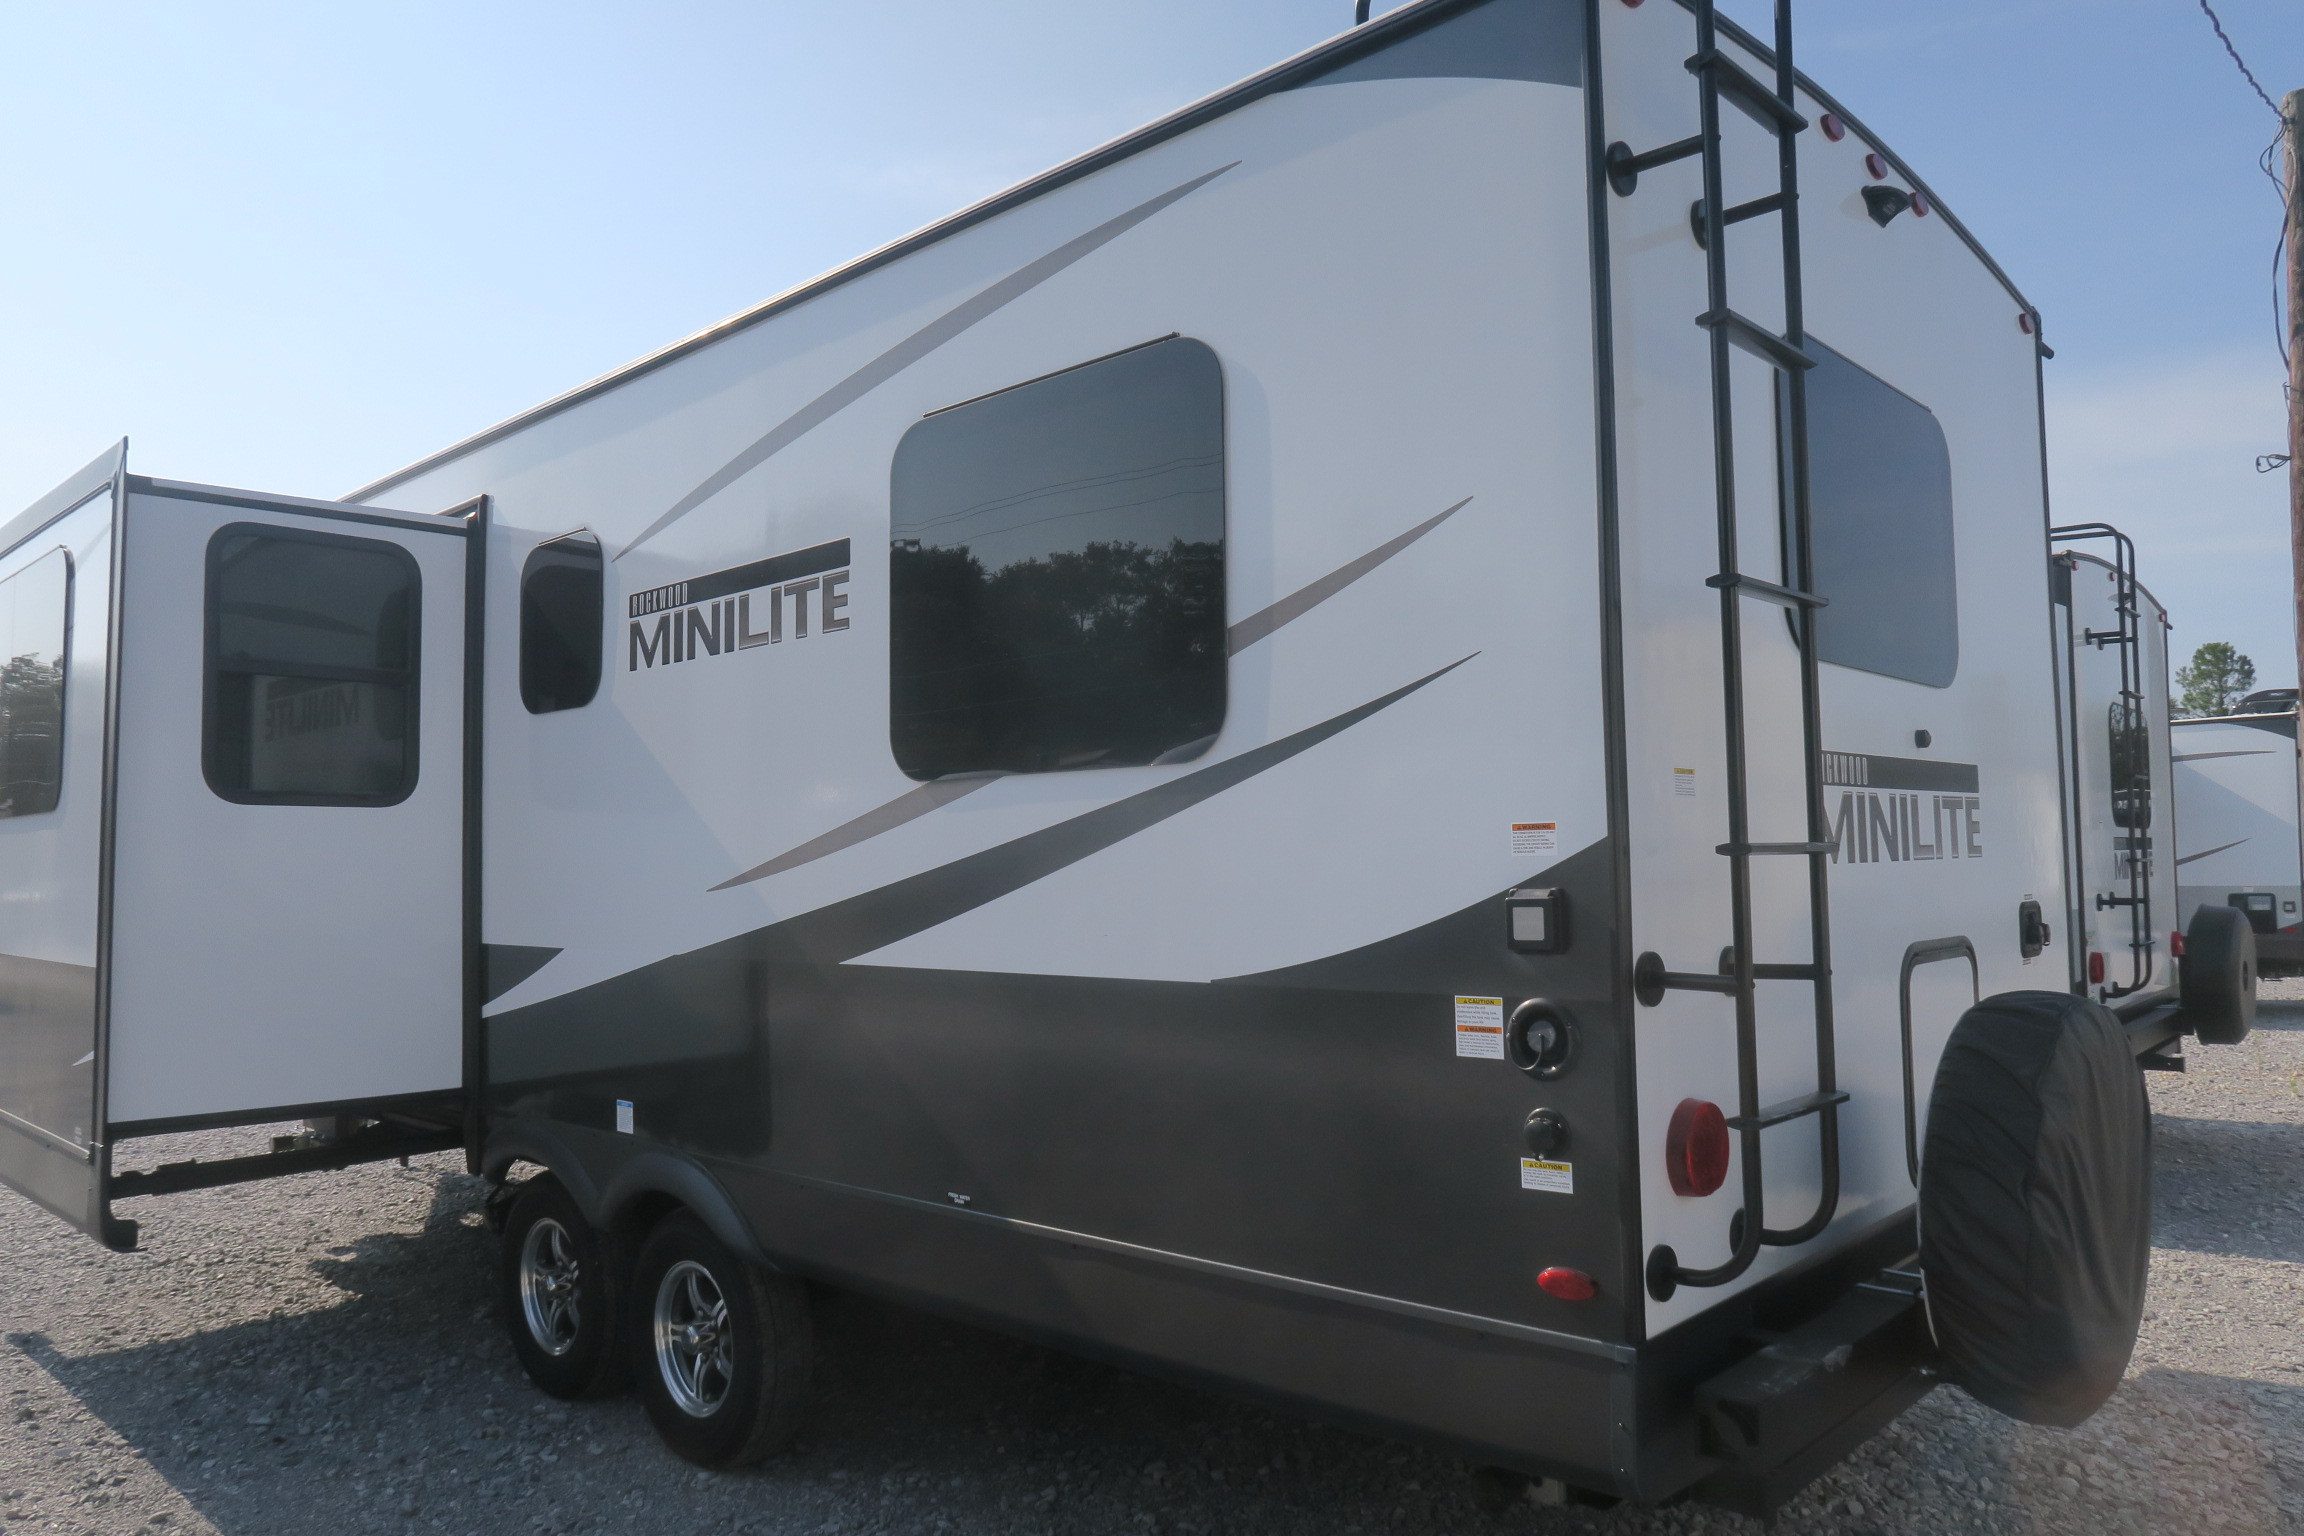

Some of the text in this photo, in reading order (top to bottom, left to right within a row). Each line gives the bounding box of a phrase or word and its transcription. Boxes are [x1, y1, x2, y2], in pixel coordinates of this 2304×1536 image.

[632, 582, 688, 617] ROCKWOOD
[629, 569, 850, 672] MINILITE
[1821, 753, 1868, 786] CKWOOD
[1521, 823, 1552, 831] WARNING
[1468, 1025, 1498, 1034] WARNING
[1534, 1162, 1563, 1171] CAUTION
